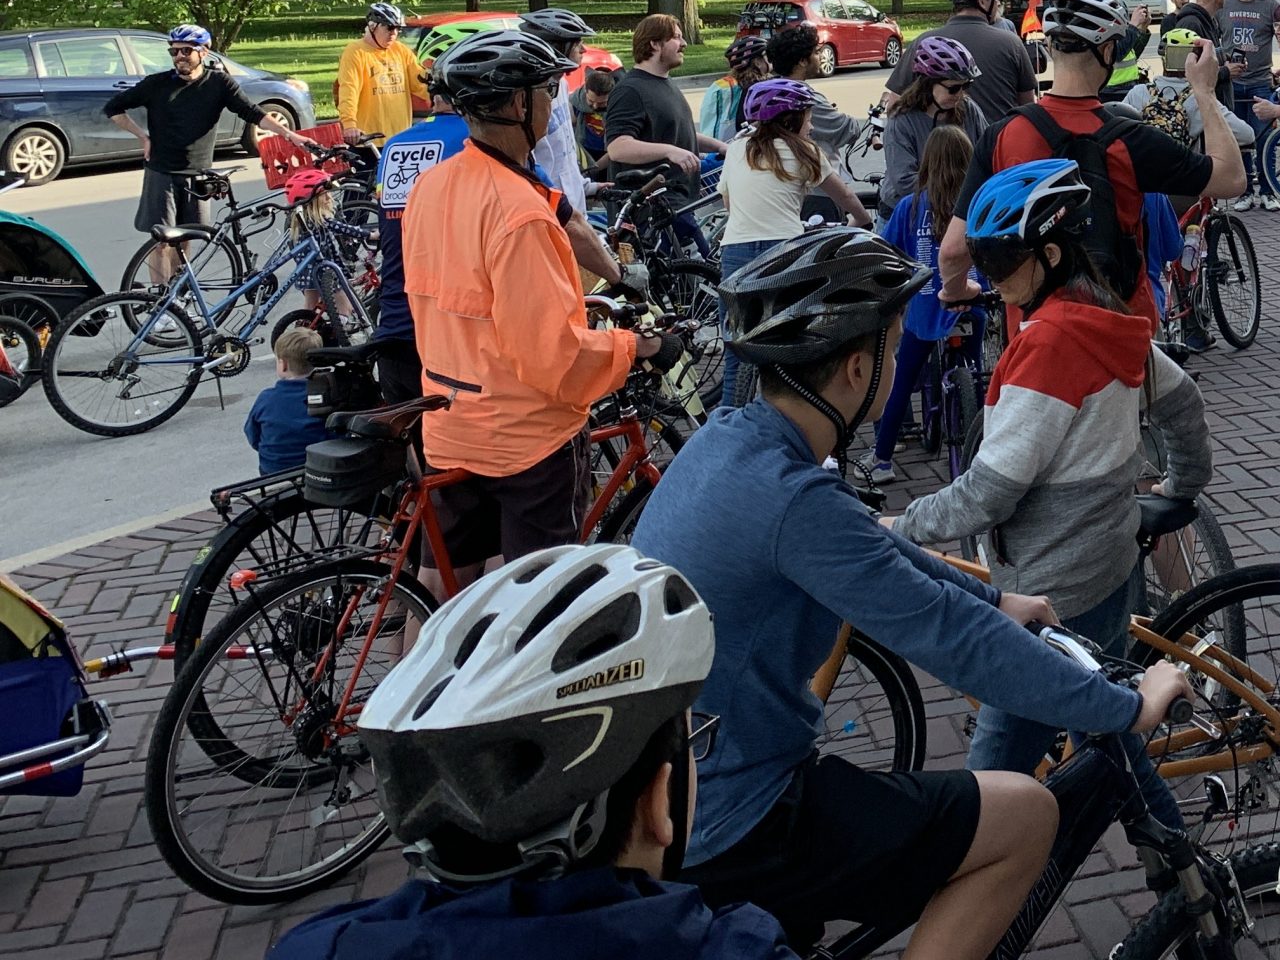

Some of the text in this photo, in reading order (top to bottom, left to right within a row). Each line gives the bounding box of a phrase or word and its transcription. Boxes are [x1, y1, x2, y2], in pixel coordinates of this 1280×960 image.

[1229, 11, 1261, 19] RIVERSIDE
[1232, 27, 1255, 45] 5K
[390, 146, 436, 164] cycle
[13, 275, 73, 285] BURLEY
[556, 658, 645, 699] SPECIALIZED
